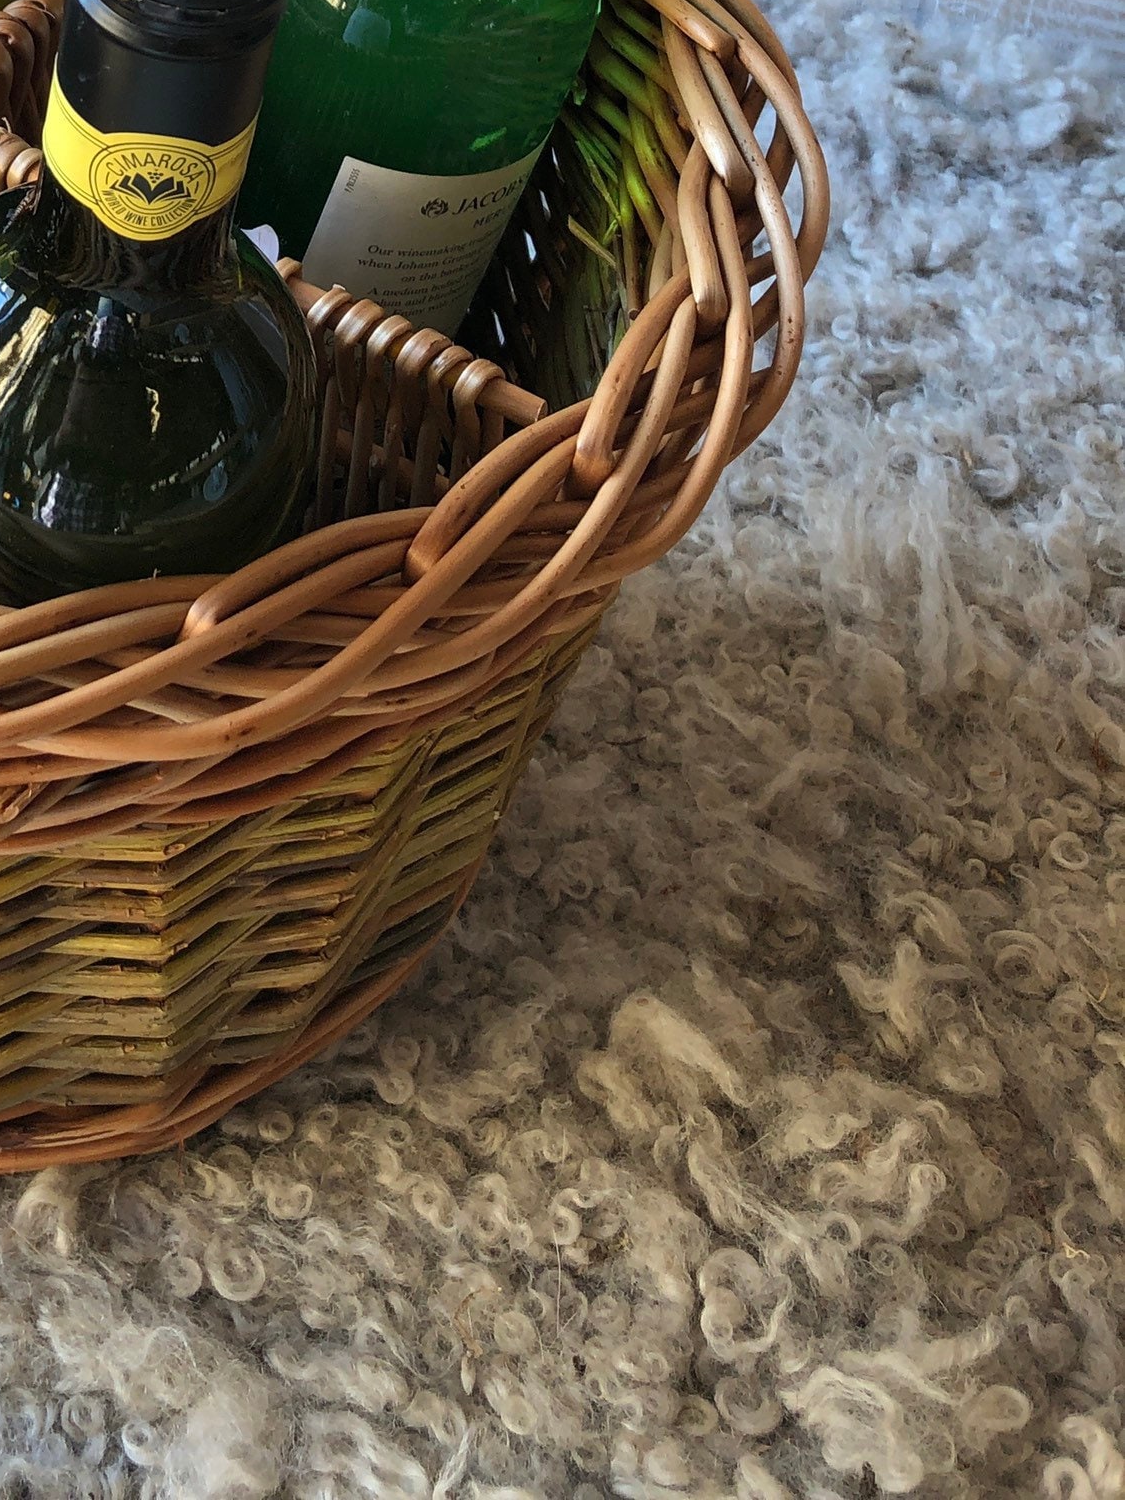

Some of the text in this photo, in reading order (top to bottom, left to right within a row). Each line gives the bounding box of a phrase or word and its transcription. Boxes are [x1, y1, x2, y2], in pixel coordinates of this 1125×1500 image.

[105, 152, 204, 184] CIMAROSA
[101, 189, 198, 227] WORLD WINE COLLECTION
[367, 243, 466, 258] Our winemaking
[357, 258, 392, 270] when
[394, 260, 439, 271] Johann
[401, 274, 416, 283] on
[419, 271, 437, 282] the
[366, 286, 378, 296] A
[382, 284, 429, 298] medium
[404, 296, 427, 307] and
